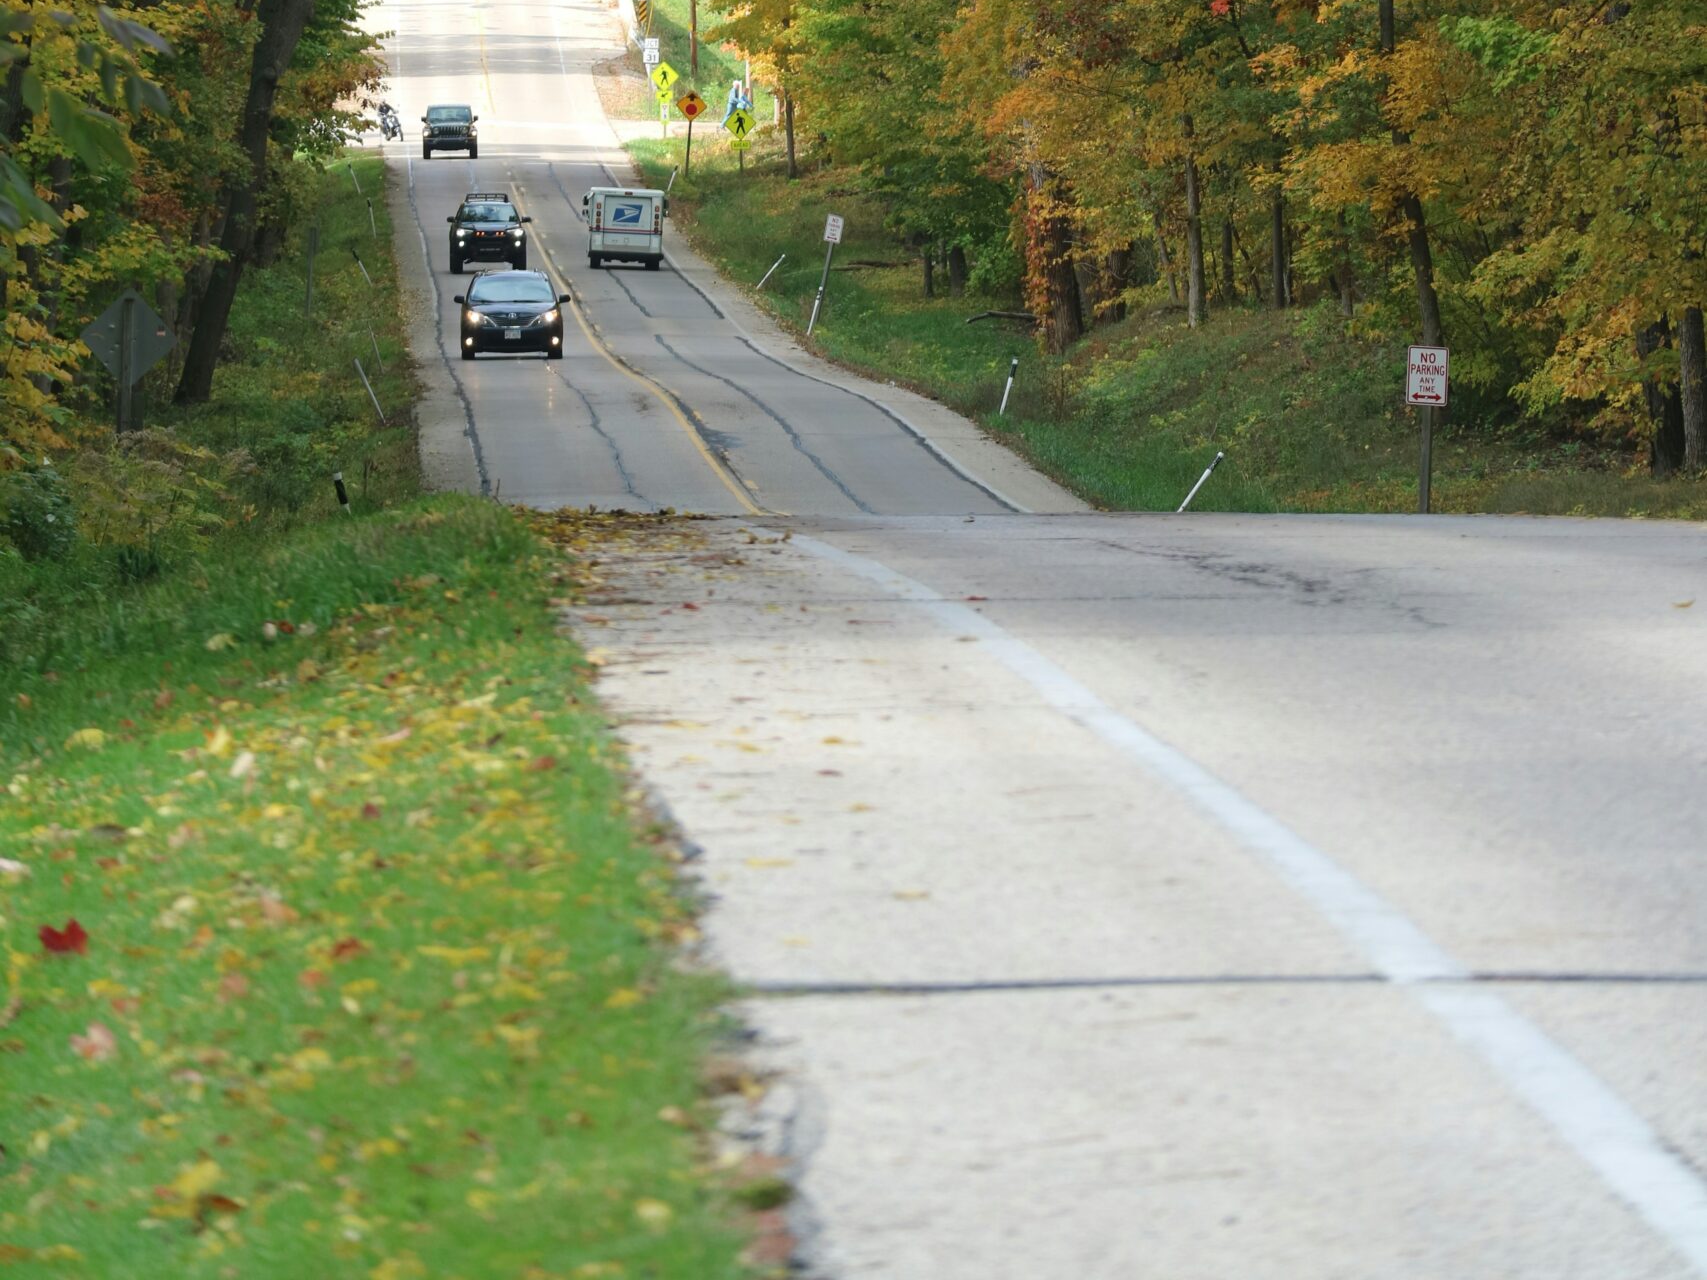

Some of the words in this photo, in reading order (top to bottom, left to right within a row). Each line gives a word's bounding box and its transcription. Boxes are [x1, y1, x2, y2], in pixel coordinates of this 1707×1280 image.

[646, 54, 656, 62] 31
[1420, 352, 1437, 364] NO
[1411, 364, 1445, 376] PARKING
[1419, 376, 1435, 385] ANY
[1419, 385, 1436, 393] TIME
